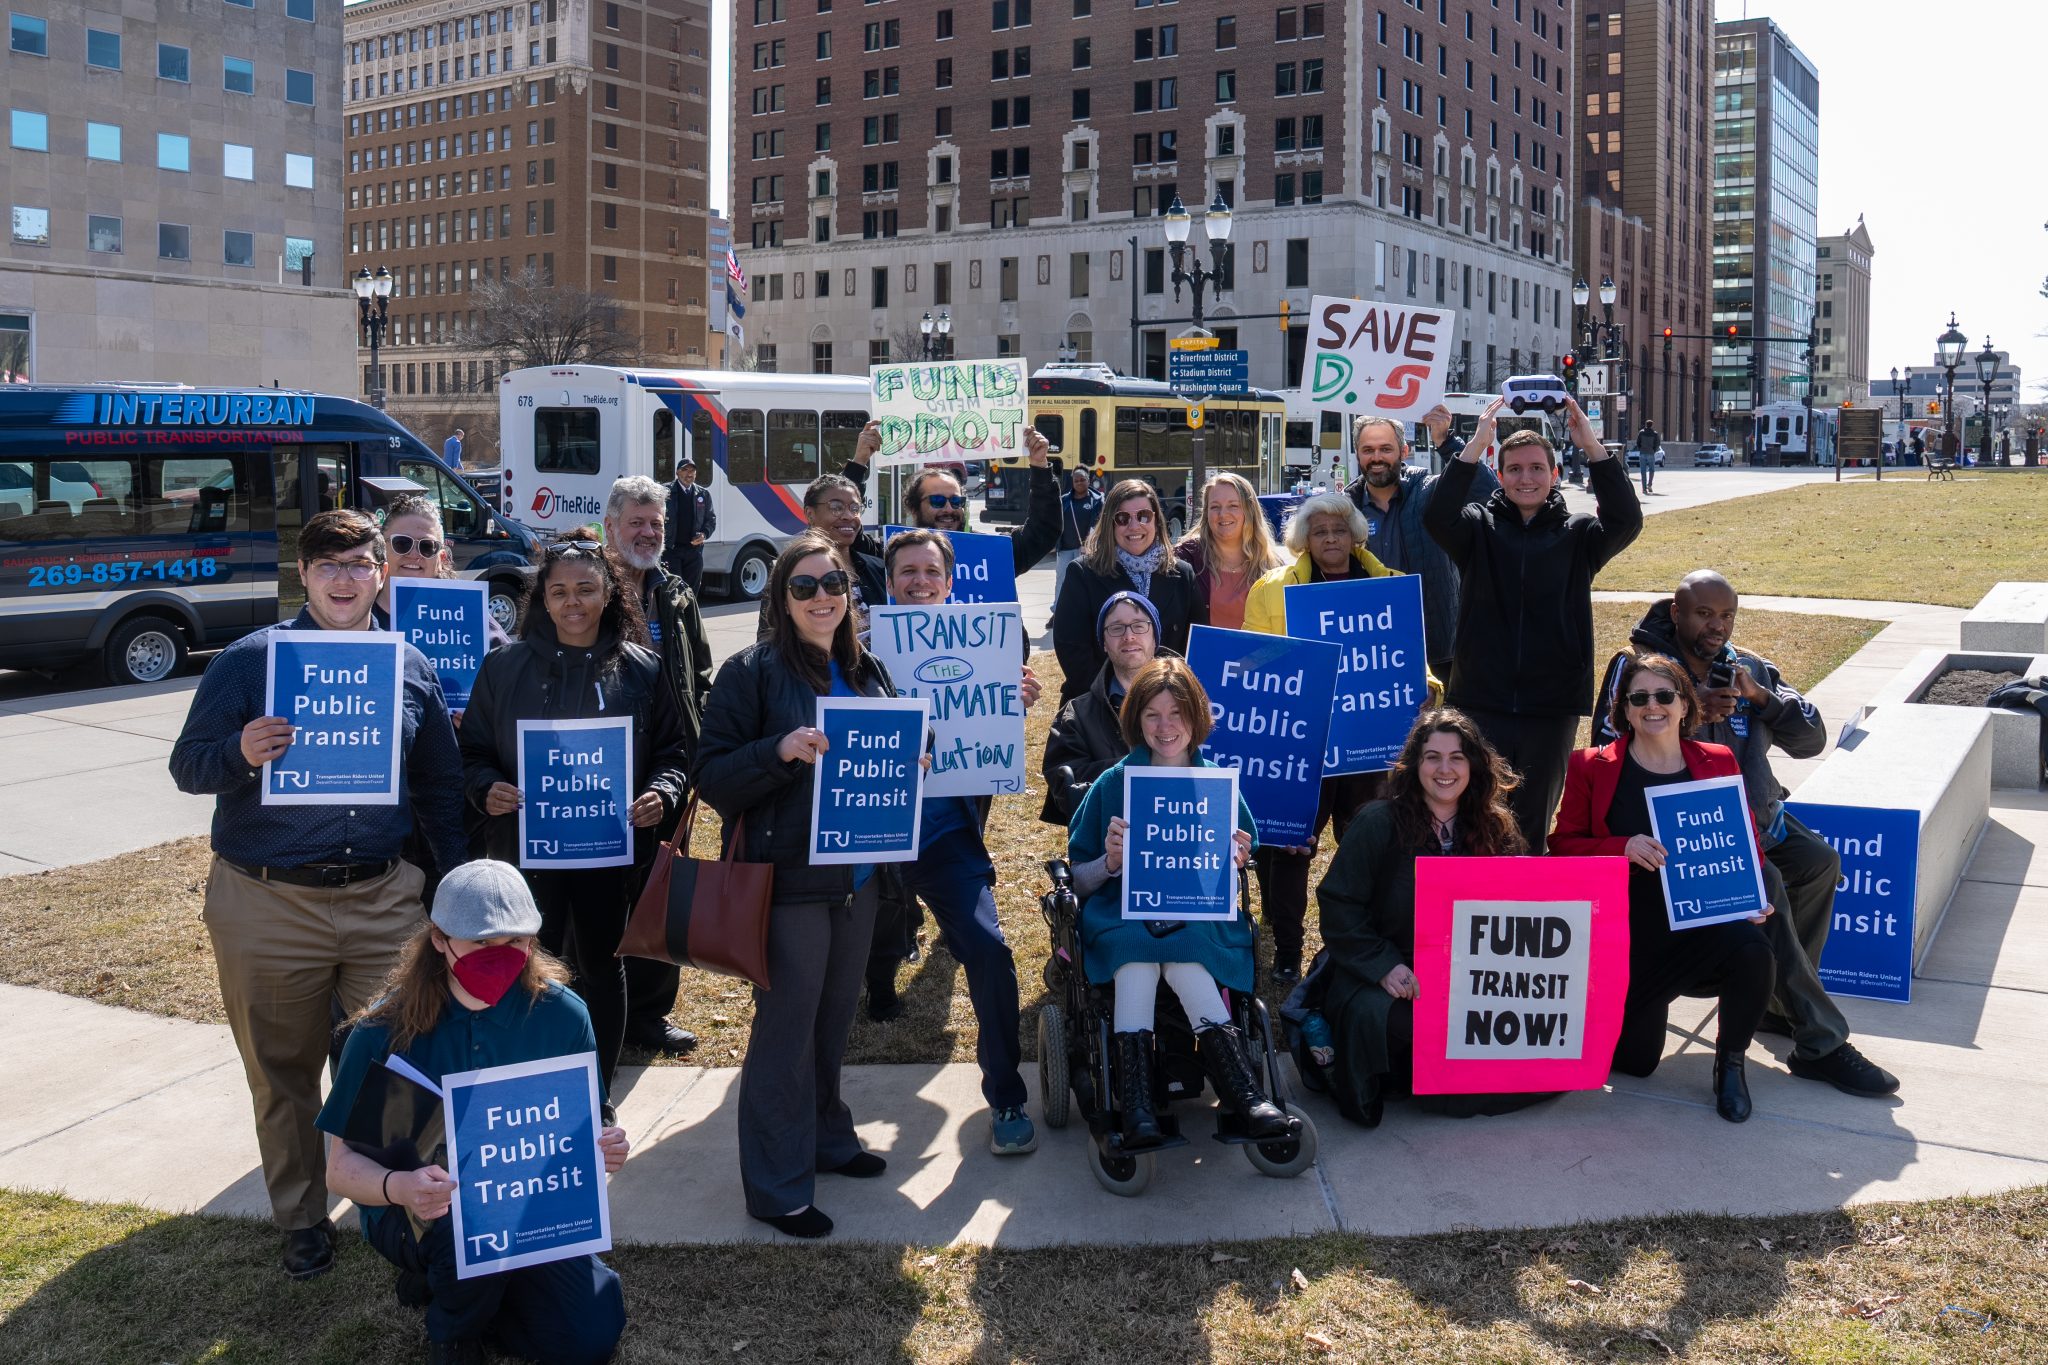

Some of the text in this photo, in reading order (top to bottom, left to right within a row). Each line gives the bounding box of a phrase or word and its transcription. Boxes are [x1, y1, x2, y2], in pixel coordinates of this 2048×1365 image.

[1317, 303, 1441, 362] SAVE
[1180, 352, 1238, 363] Riverfront District
[1180, 367, 1232, 377] Stadium District
[878, 363, 1017, 402] FUND
[1180, 383, 1242, 395] Washington Square
[100, 394, 315, 425] INTERURBAN
[518, 395, 534, 408] 678
[583, 395, 619, 406] TheRide.org
[65, 429, 304, 445] PUBLIC TRANSPORTATION
[881, 409, 1023, 455] DDOT
[389, 436, 401, 449] 35
[555, 495, 601, 514] TheRide
[28, 558, 216, 587] 269-857-1418
[951, 558, 989, 582] nd
[417, 604, 464, 621] Fund
[1320, 604, 1393, 636] Fund
[412, 628, 471, 645] Public
[428, 654, 476, 670] ansit
[1338, 644, 1405, 674] ublic
[303, 664, 368, 684] Fund
[927, 664, 962, 678] THE
[1221, 660, 1304, 697] Fund
[294, 695, 376, 715] Public
[1331, 682, 1414, 713] ransit
[1211, 702, 1308, 740] Public
[291, 726, 381, 746] Transit
[847, 730, 900, 749] Fund
[548, 747, 603, 766] Fund
[1346, 748, 1386, 756] Transportation
[838, 759, 906, 778] Public
[541, 774, 611, 793] Public
[831, 788, 908, 807] Transit
[1154, 796, 1208, 815] Fund
[536, 800, 617, 819] Transit
[1676, 806, 1724, 828] Fund
[1146, 824, 1215, 842] Public
[1676, 832, 1736, 854] Public
[1140, 851, 1220, 870] Transit
[1674, 856, 1746, 880] Transit
[1836, 869, 1892, 896] lic
[1833, 910, 1897, 936] nsit
[1470, 915, 1572, 958] FUND
[1469, 970, 1570, 999] TRANSIT
[1818, 968, 1902, 982] ansportation Riders United
[1465, 1010, 1568, 1047] NOW!
[487, 1096, 561, 1131] Fund
[480, 1132, 574, 1168] Public
[474, 1165, 583, 1204] Transit
[515, 1226, 556, 1238] Transportation
[556, 1221, 574, 1230] Riders
[574, 1217, 593, 1226] United
